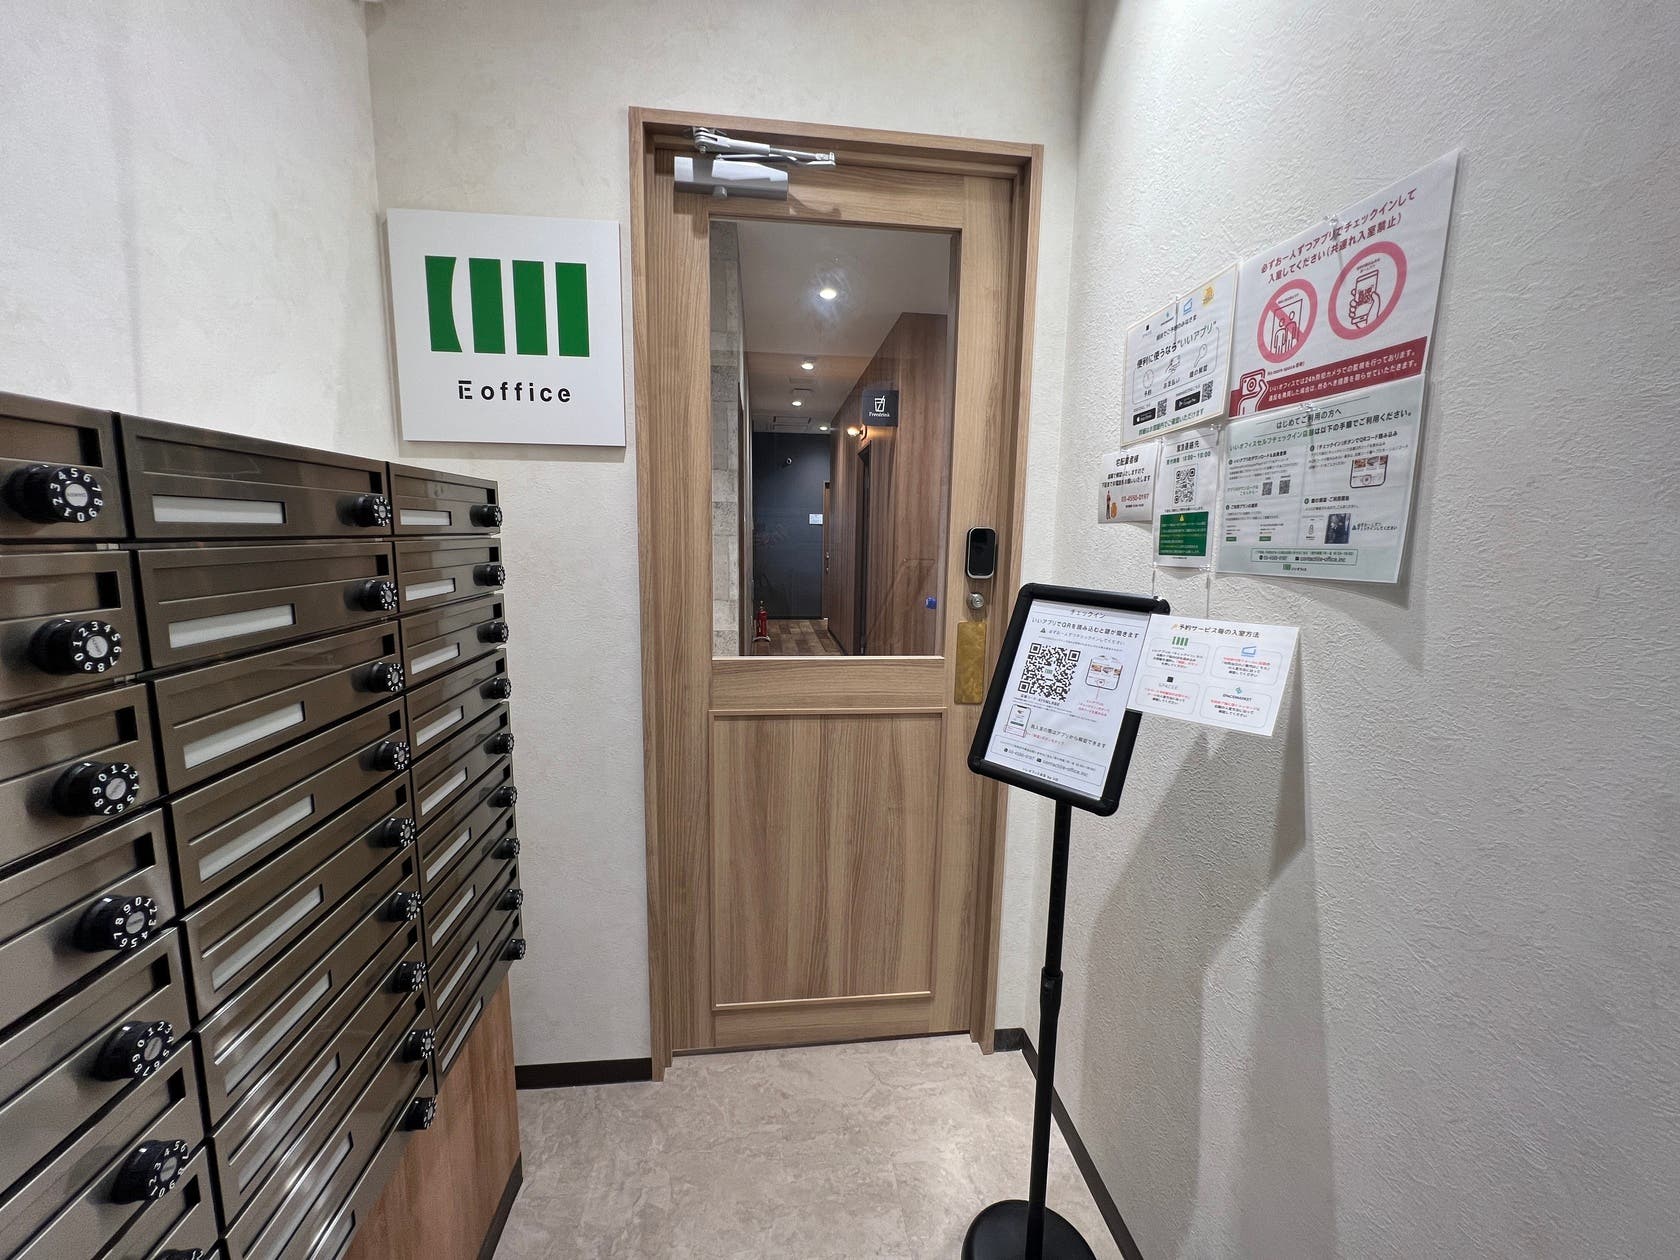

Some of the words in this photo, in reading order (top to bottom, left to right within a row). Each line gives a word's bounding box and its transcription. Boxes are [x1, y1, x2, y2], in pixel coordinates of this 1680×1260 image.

[1261, 188, 1417, 273] 必ずお一人ずつアプリでチェックインして
[1276, 409, 1342, 429] はじめてご利用の方へ
[1070, 609, 1106, 619] チェックイン
